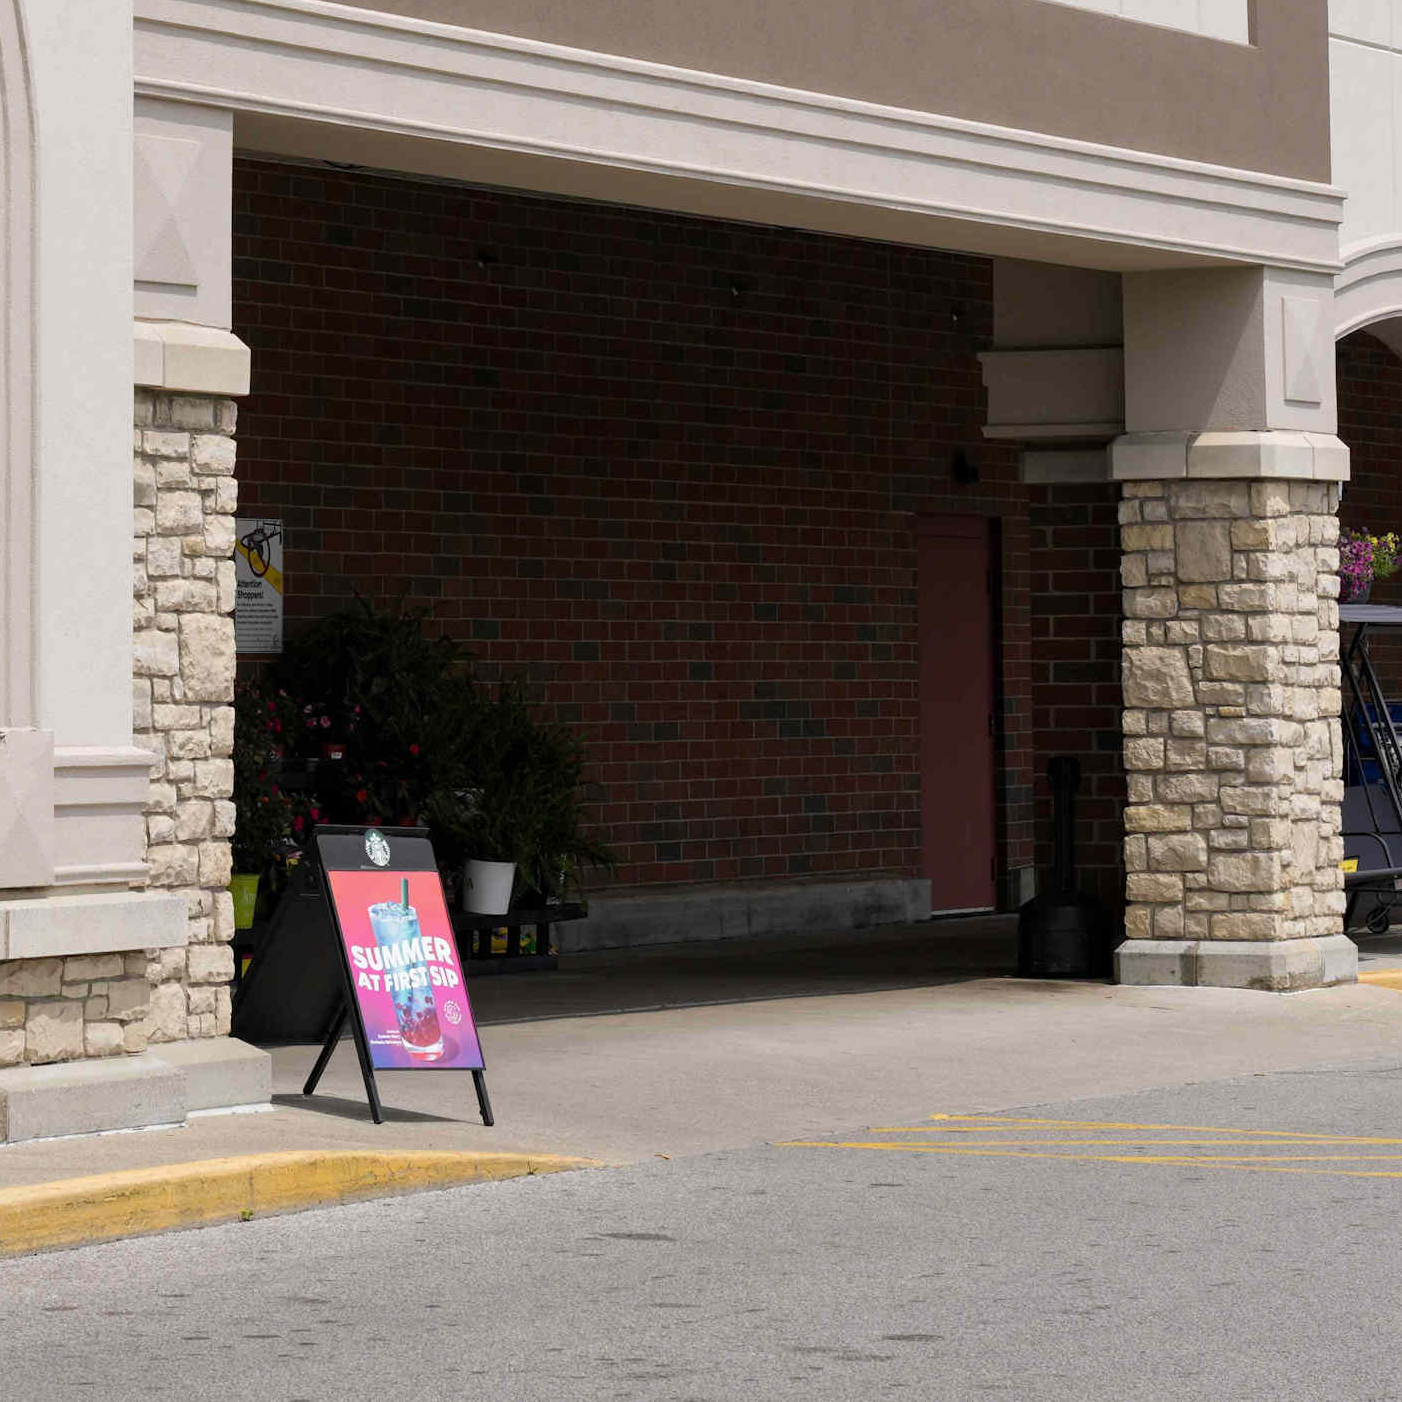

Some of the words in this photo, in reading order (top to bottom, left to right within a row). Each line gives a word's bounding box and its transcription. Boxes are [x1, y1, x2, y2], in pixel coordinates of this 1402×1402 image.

[237, 590, 264, 601] Shoppers!
[351, 936, 455, 971] SUMMER
[358, 972, 381, 993] AT
[383, 966, 429, 993] FIRST
[429, 965, 460, 989] SIP
